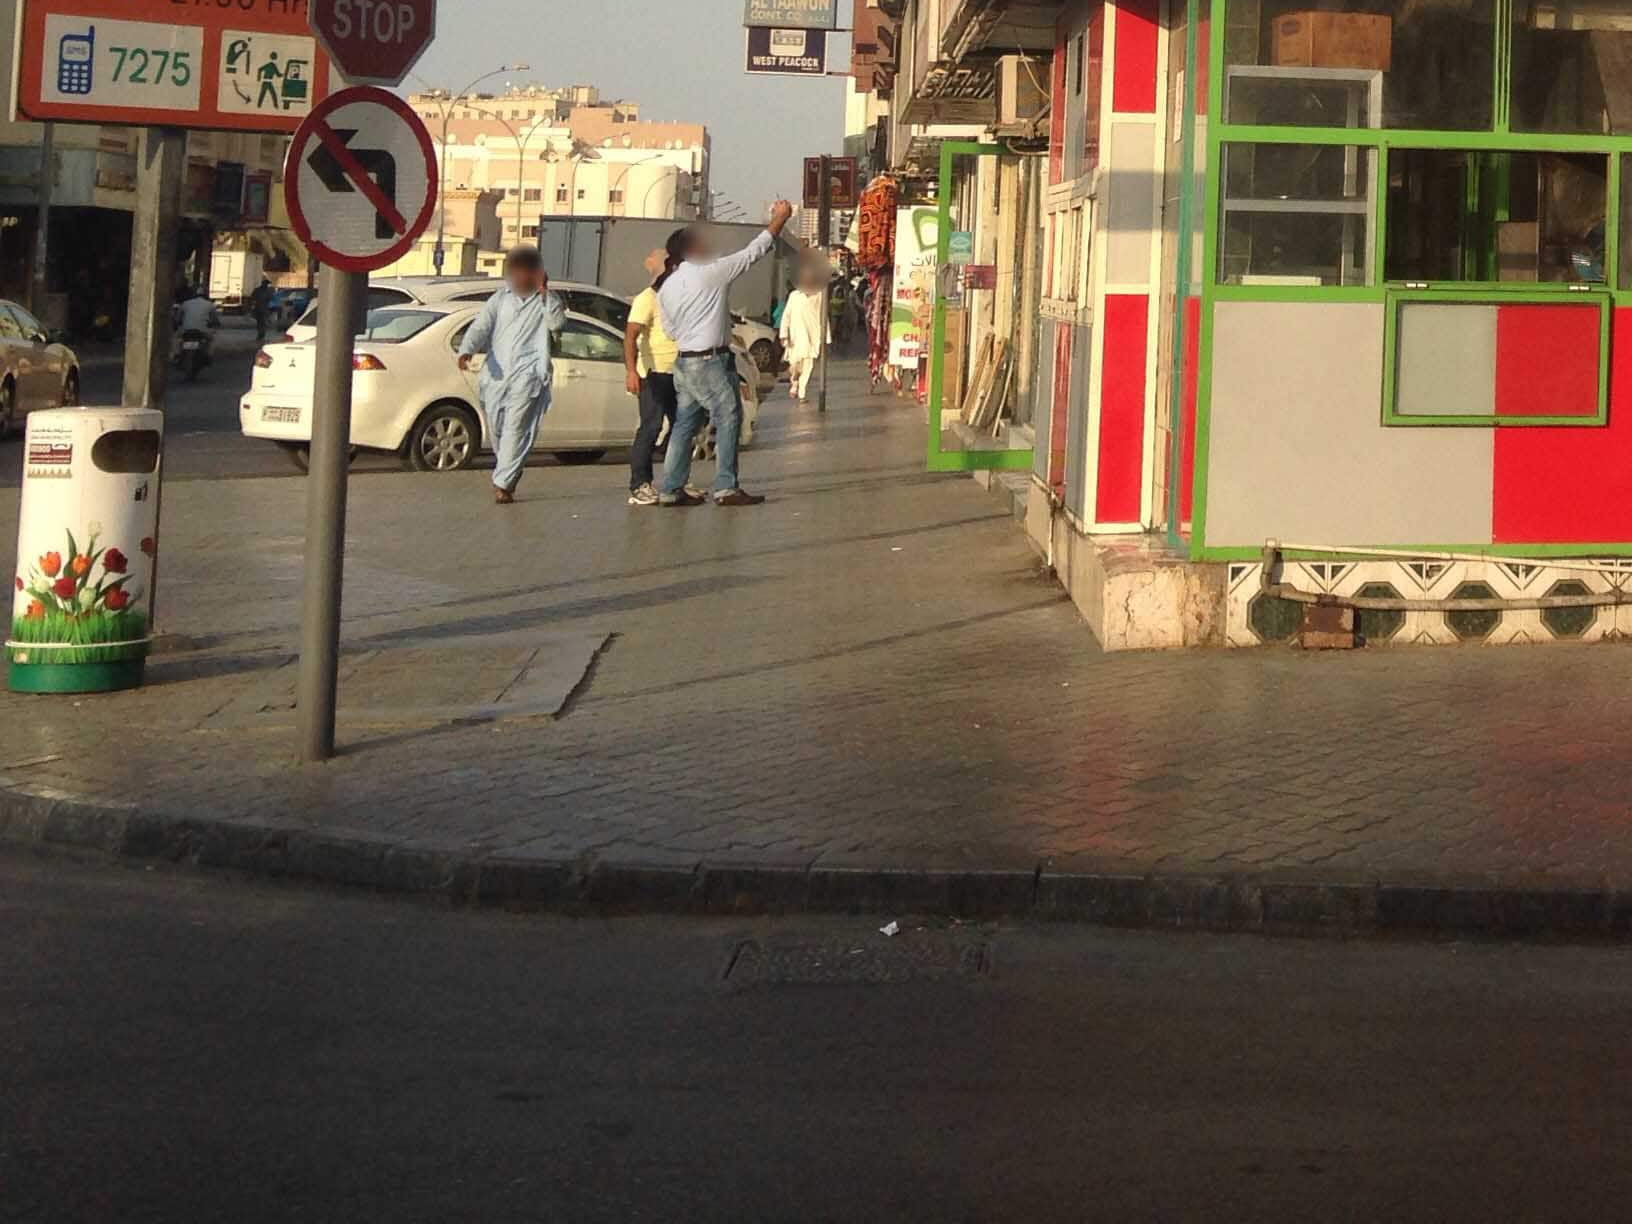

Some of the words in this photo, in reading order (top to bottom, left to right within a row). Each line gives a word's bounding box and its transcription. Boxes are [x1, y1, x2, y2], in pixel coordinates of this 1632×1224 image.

[108, 46, 192, 88] 7275
[753, 56, 777, 66] WEST
[778, 57, 819, 67] PEACOCK
